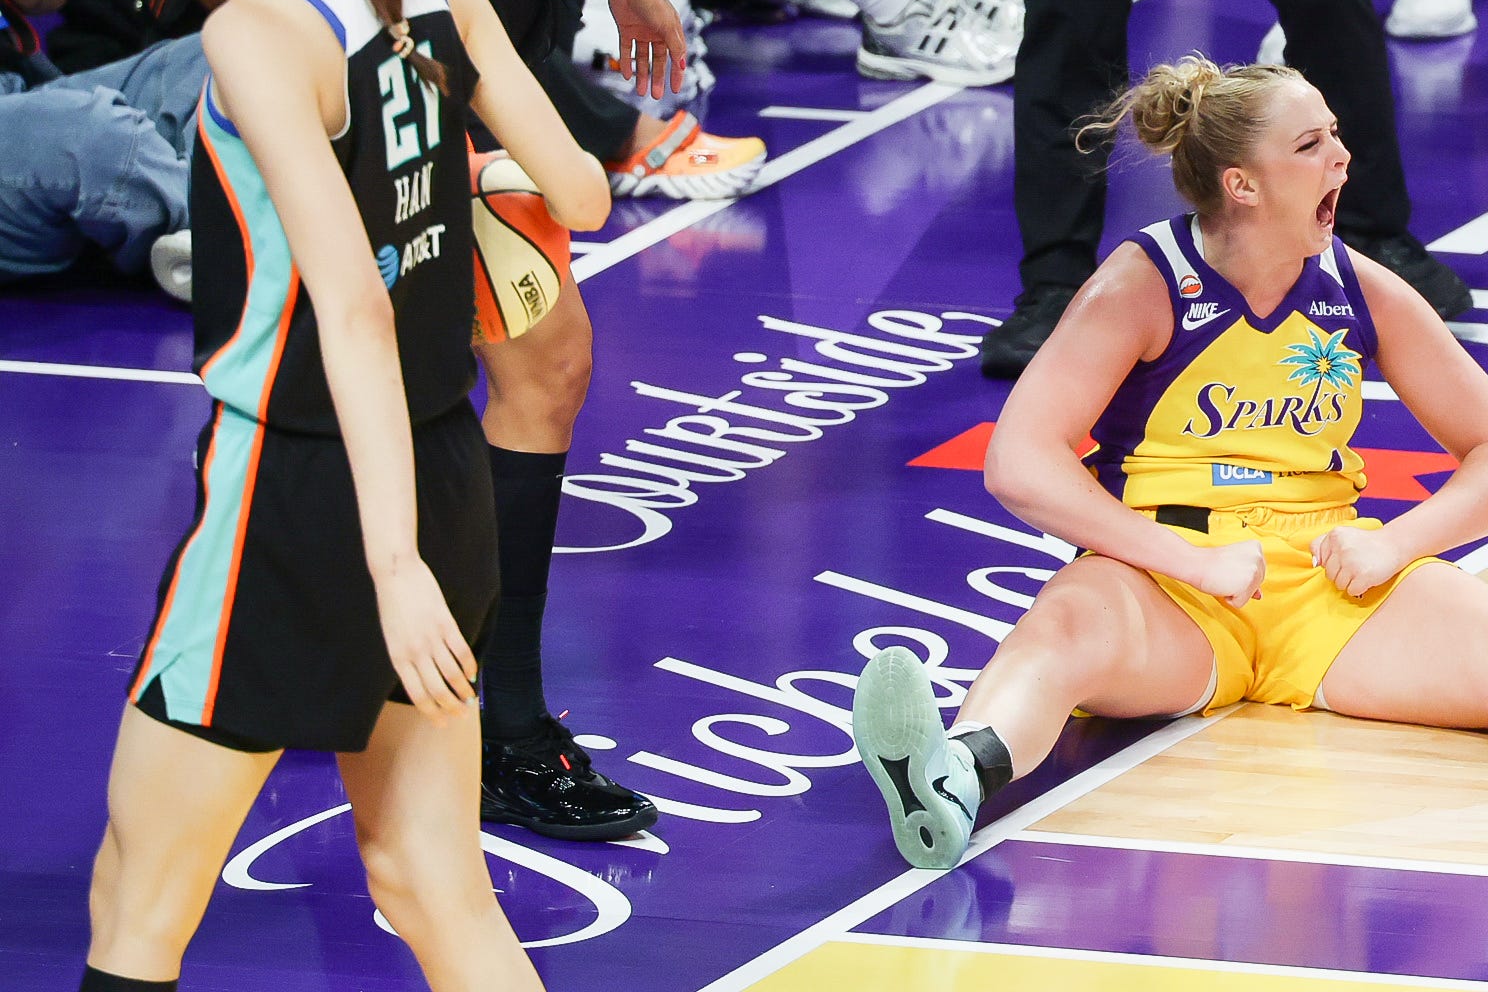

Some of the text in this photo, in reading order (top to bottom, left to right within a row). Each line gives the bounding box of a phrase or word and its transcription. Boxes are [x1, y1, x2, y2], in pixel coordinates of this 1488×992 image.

[377, 40, 440, 171] 21
[394, 161, 433, 225] HAN
[400, 223, 446, 277] AT&T
[1189, 302, 1219, 319] NIKE
[1308, 300, 1354, 317] Albert
[1181, 382, 1347, 439] SPARKS
